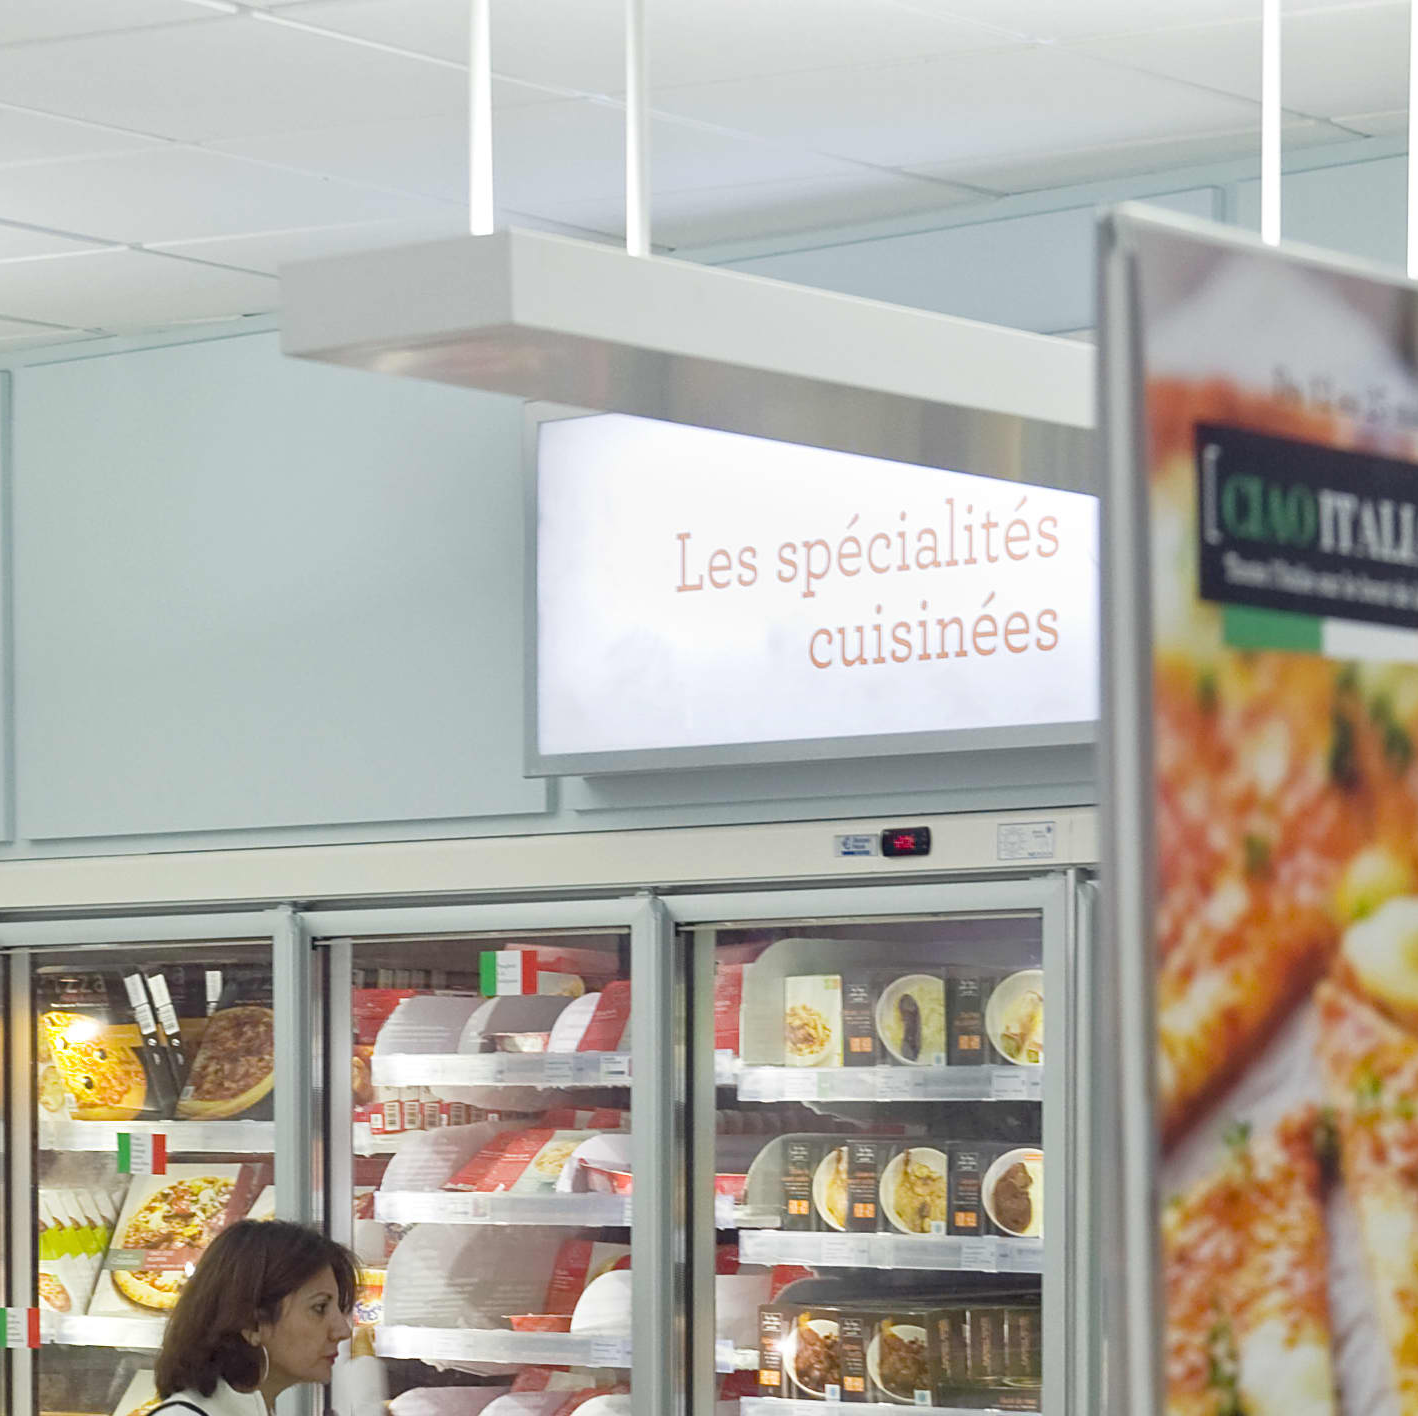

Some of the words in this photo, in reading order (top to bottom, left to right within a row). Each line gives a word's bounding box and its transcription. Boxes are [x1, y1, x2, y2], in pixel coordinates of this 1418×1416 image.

[675, 531, 758, 593] Les
[776, 495, 1060, 598] spécialités
[808, 591, 1060, 670] cuisinées
